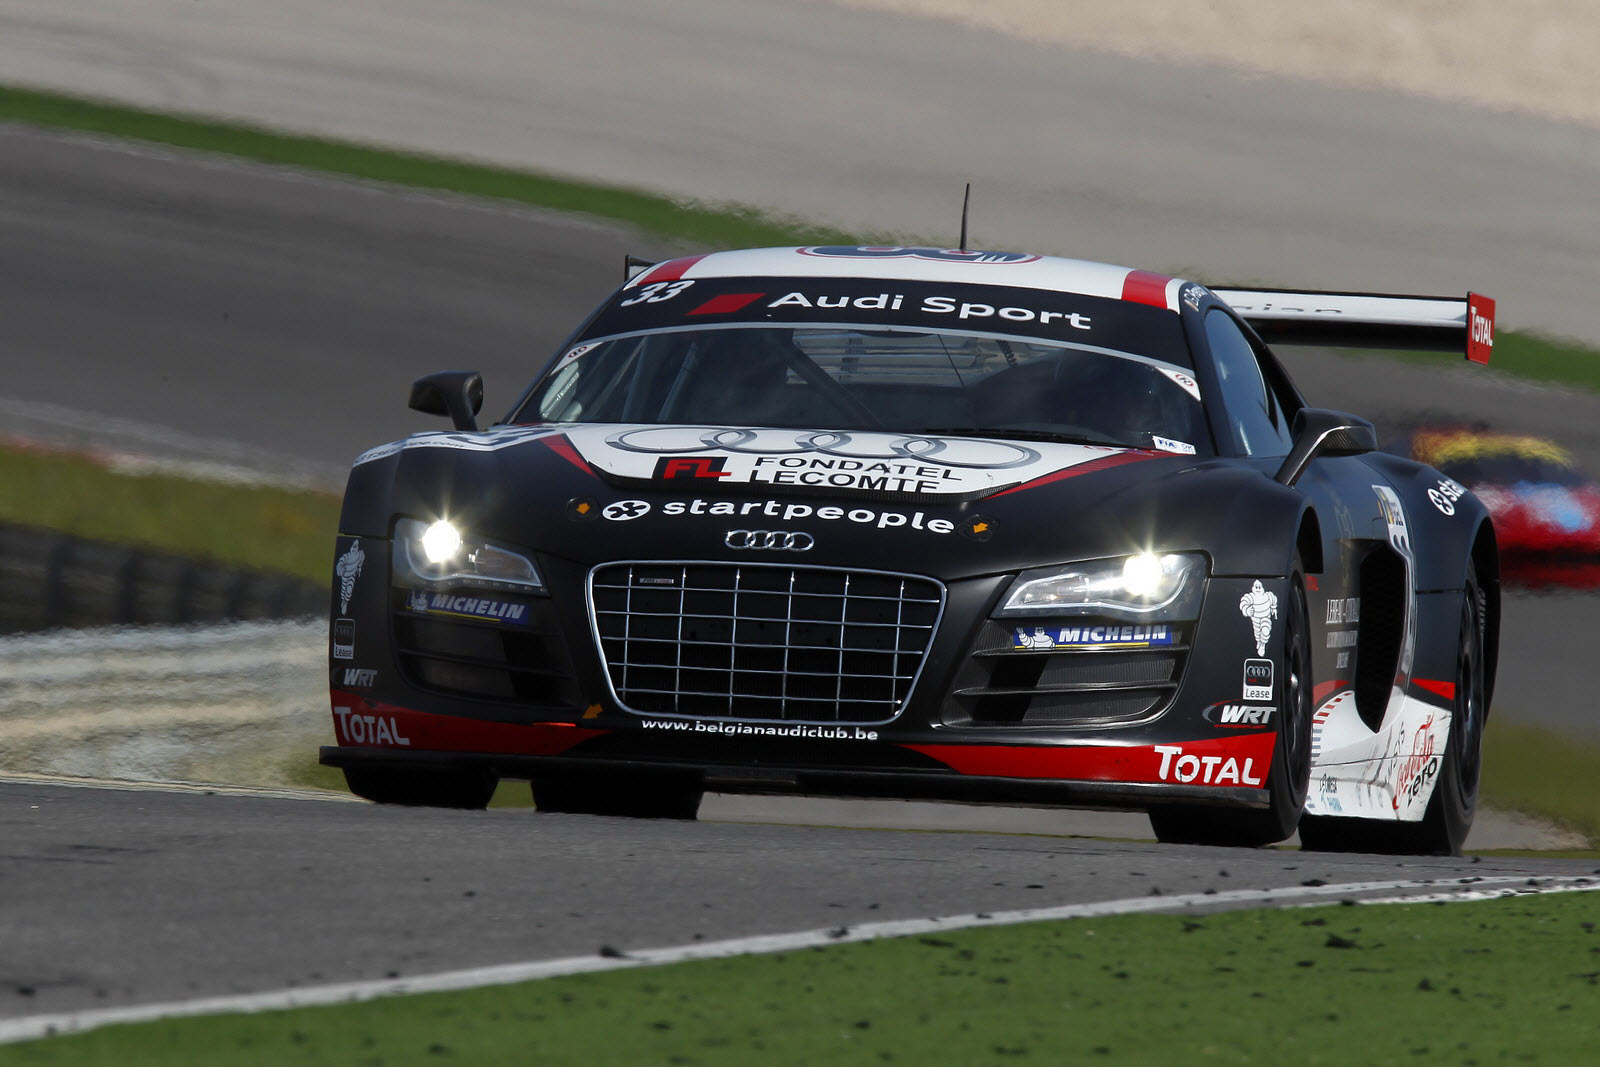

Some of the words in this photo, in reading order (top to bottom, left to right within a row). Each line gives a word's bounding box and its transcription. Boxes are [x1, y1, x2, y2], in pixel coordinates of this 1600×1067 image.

[620, 279, 696, 308] 33
[767, 292, 904, 310] Audi
[920, 296, 1093, 331] Sport
[1471, 305, 1493, 347] TOTAL
[662, 459, 733, 480] FL
[749, 469, 940, 493] LECOMTE
[754, 456, 963, 482] FONDATEL
[662, 499, 956, 534] startpeople
[430, 593, 525, 620] MICHELIN
[1058, 625, 1167, 643] MICHELIN
[335, 645, 353, 658] Lease
[343, 668, 378, 688] WRT
[1245, 686, 1271, 699] Lease
[334, 706, 411, 746] TOTAL
[1220, 705, 1278, 725] WRT
[641, 719, 879, 741] www.belgianaudiclub.be
[1154, 745, 1262, 786] TOTAL
